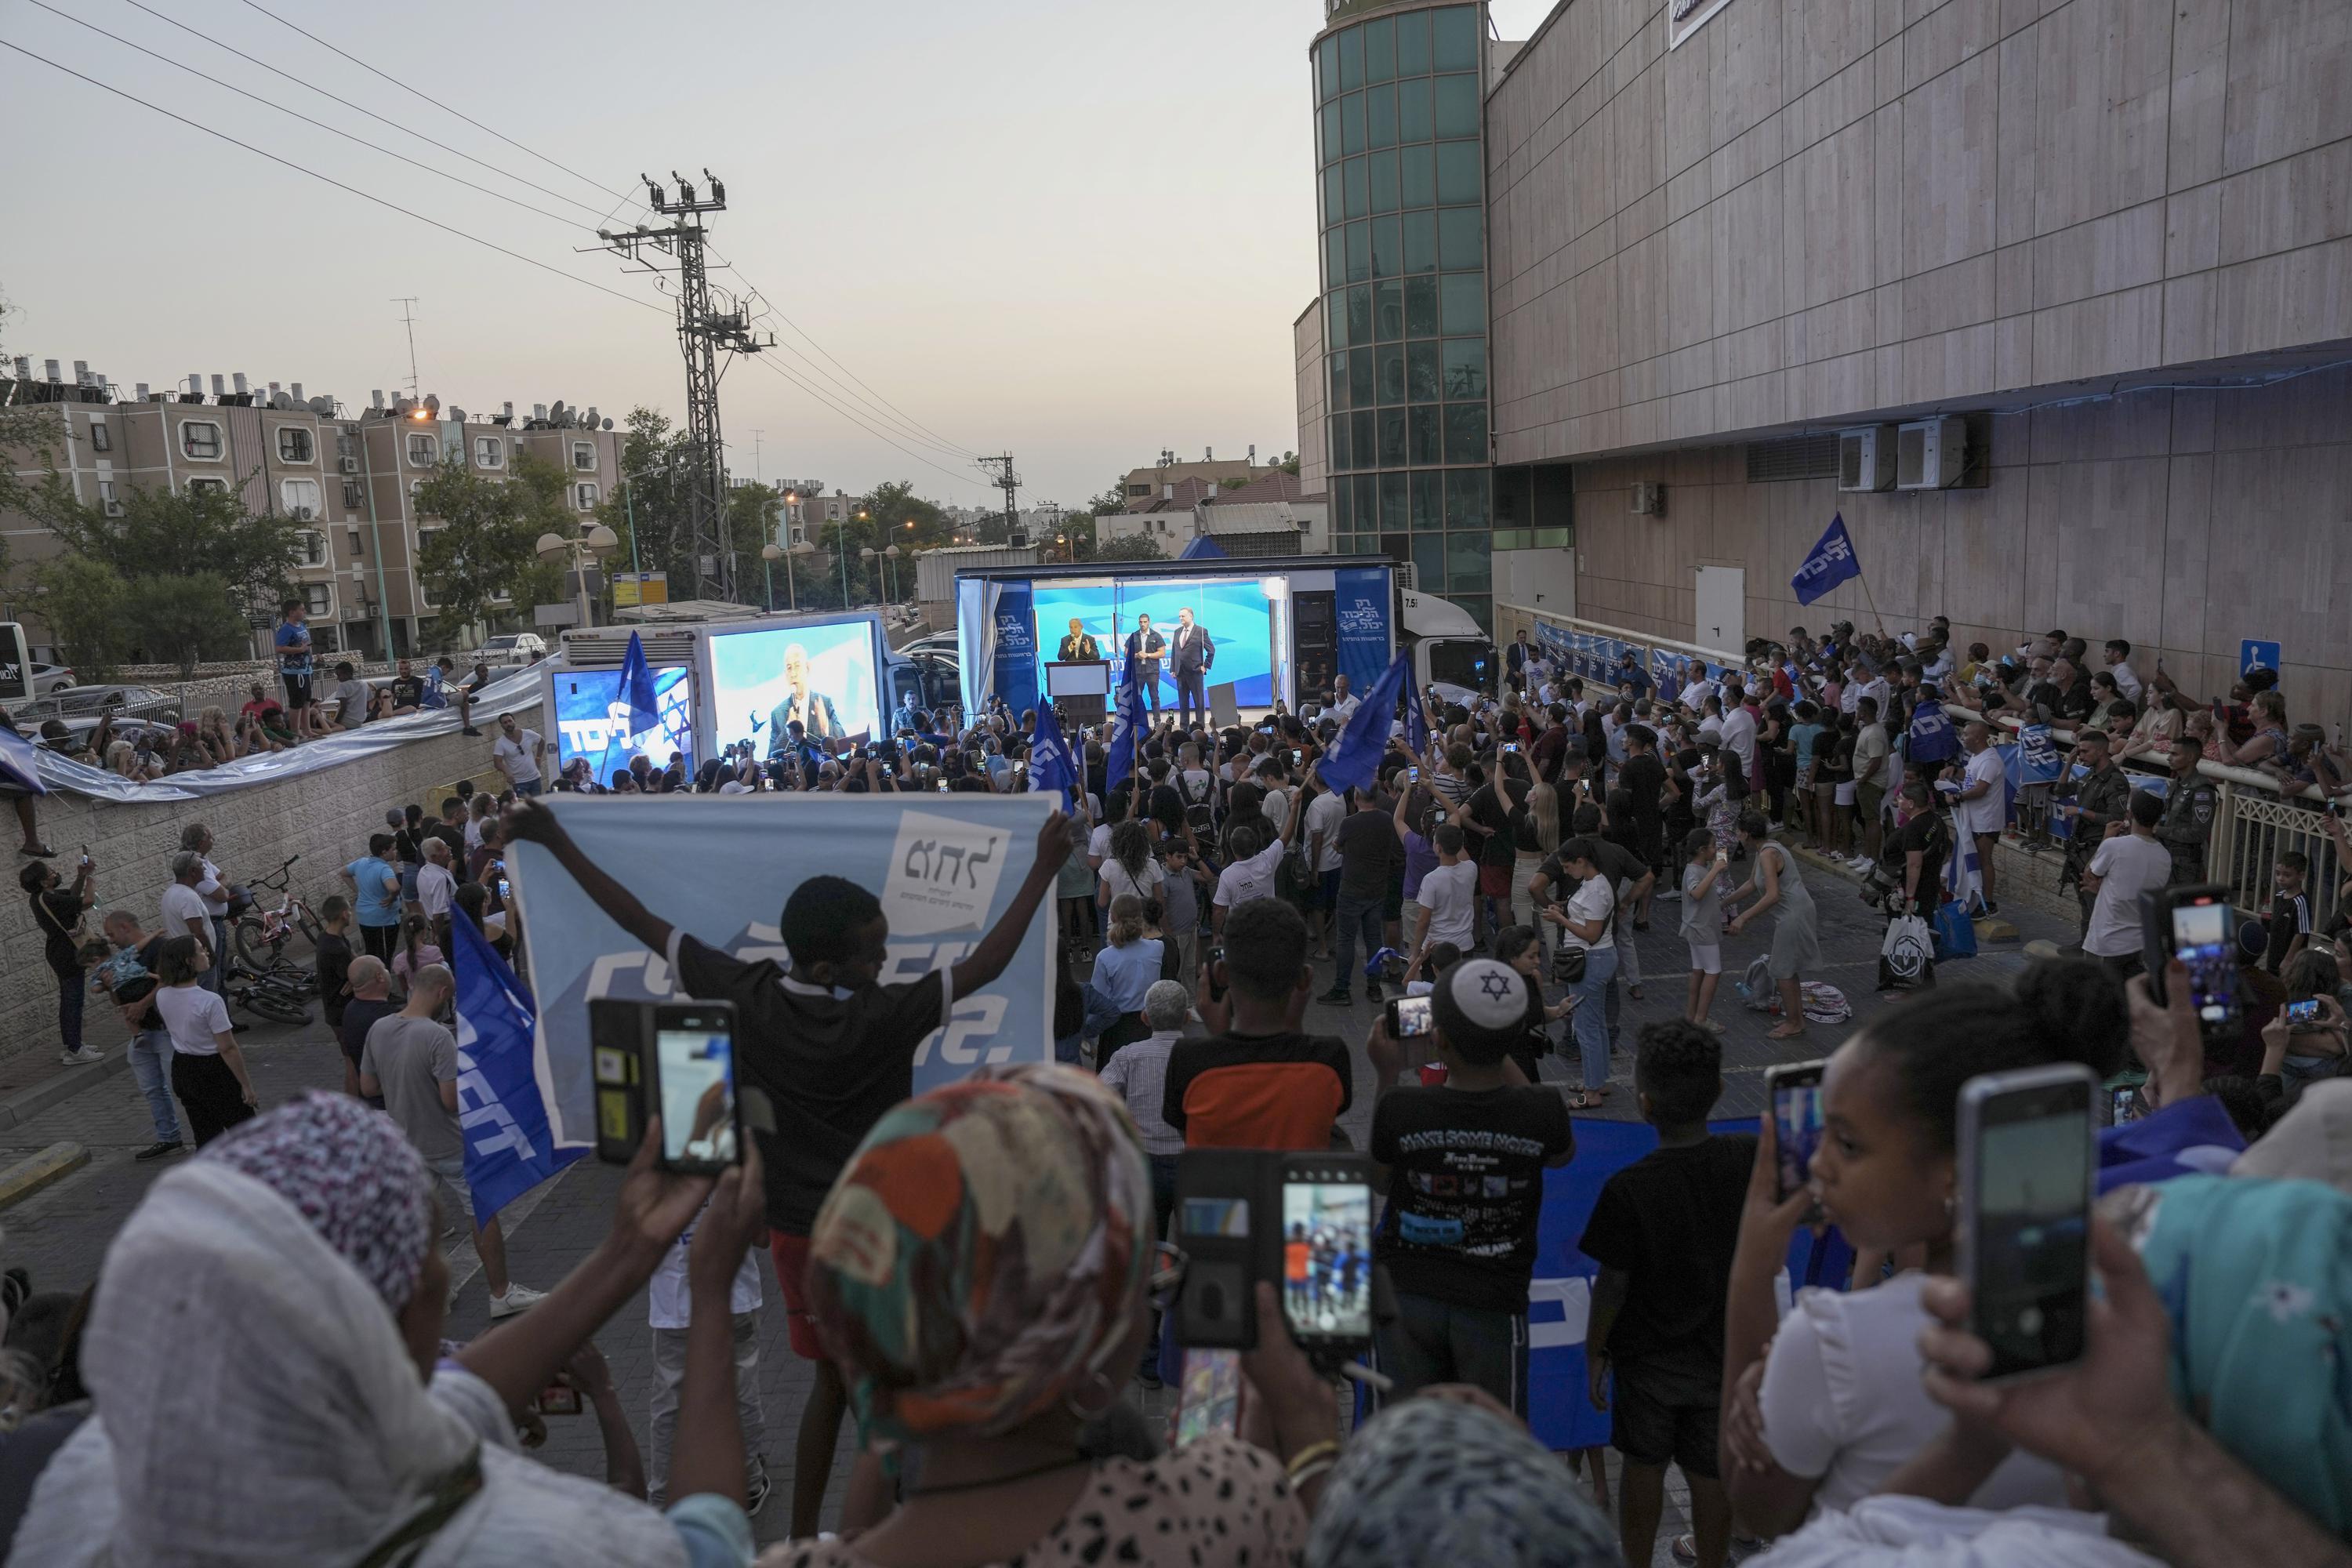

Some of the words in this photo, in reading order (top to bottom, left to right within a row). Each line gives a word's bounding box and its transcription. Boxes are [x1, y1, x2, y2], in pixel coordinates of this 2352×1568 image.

[1355, 599, 1370, 609] רק
[1406, 598, 1415, 608] 7.5
[1341, 607, 1379, 619] הליכוד
[1000, 615, 1016, 626] רק
[559, 702, 633, 752] ליכוד
[1239, 881, 1253, 891] מחל
[1399, 1130, 1444, 1152] MAKE
[1445, 1130, 1494, 1149] SOME
